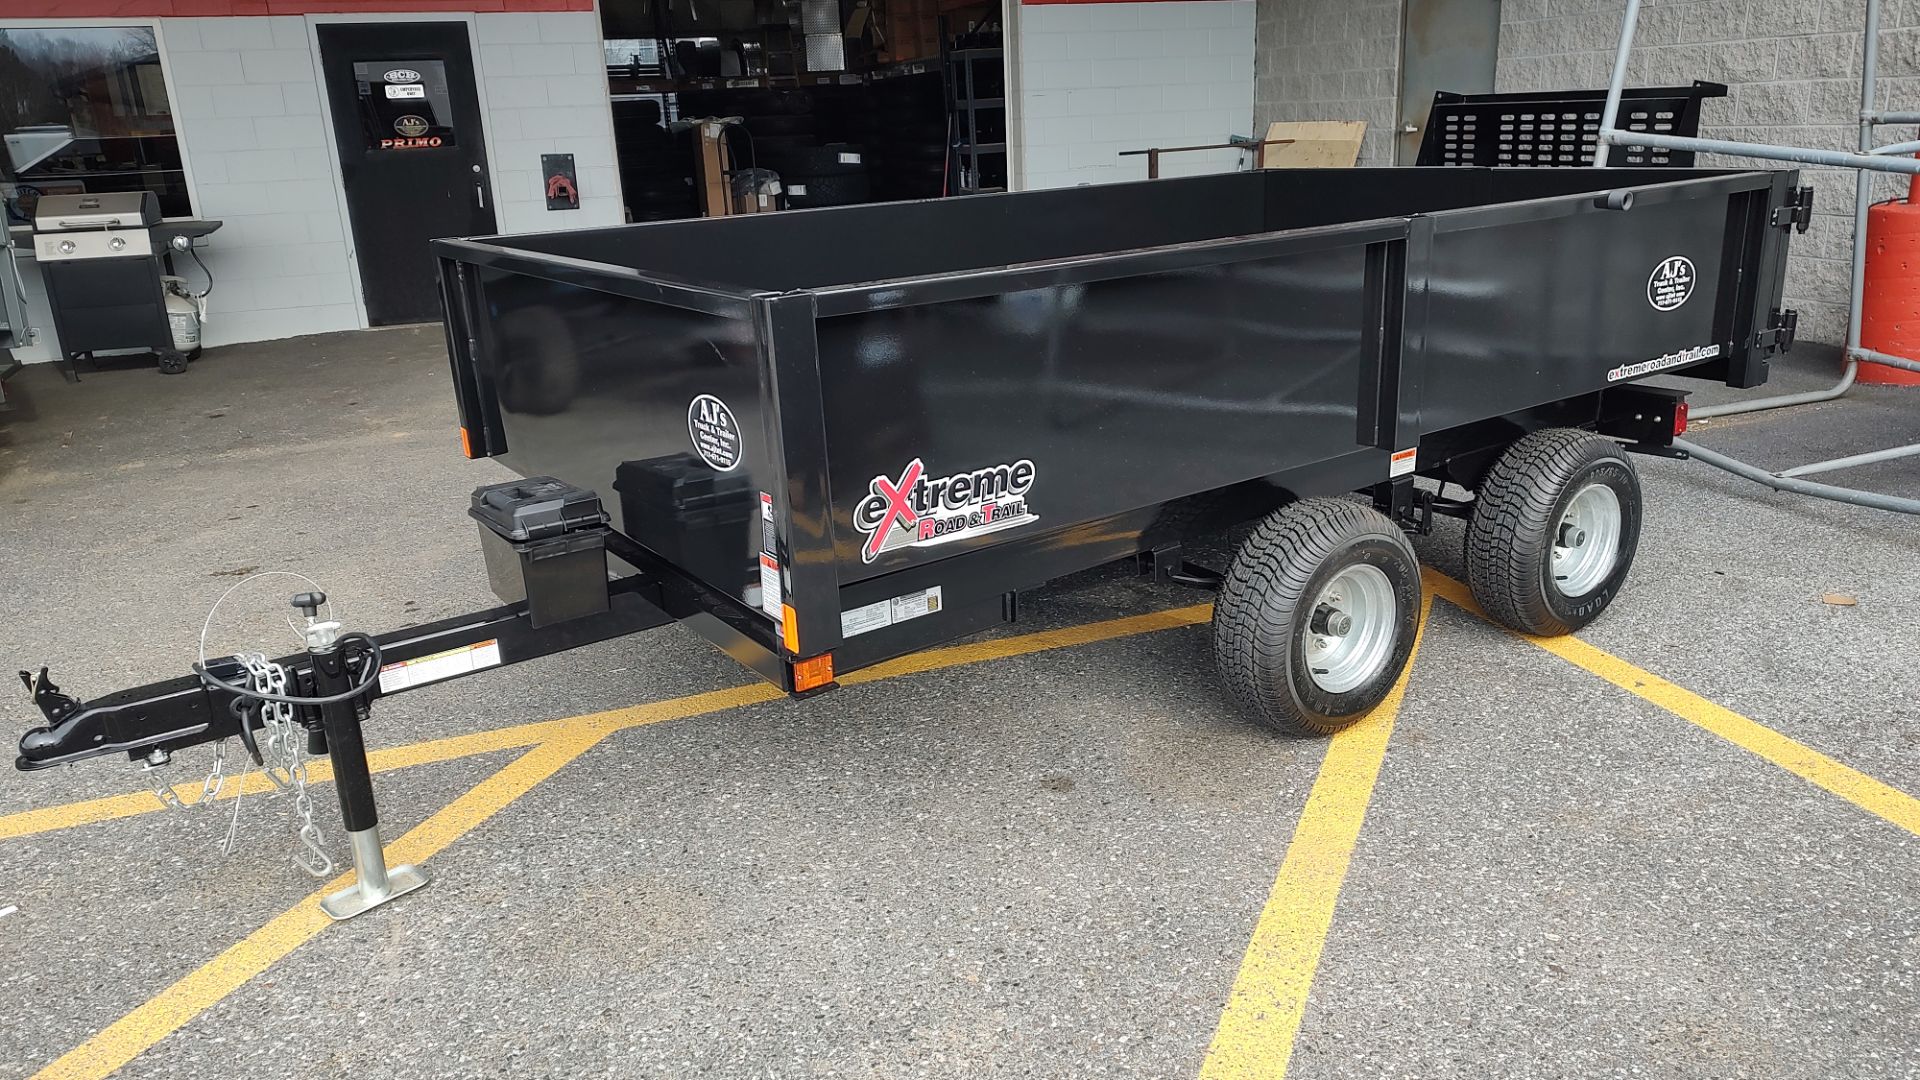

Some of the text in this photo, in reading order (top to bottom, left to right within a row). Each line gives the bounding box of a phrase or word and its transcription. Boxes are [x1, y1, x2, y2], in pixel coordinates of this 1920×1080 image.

[380, 136, 442, 150] PRIMO
[1660, 260, 1686, 279] AJ's
[1609, 345, 1719, 380] extremeroadandtrail.com
[700, 399, 727, 427] AJ's
[693, 419, 710, 432] Truck
[715, 427, 736, 441] Trailer
[918, 501, 1026, 542] ROAD & TRAIL
